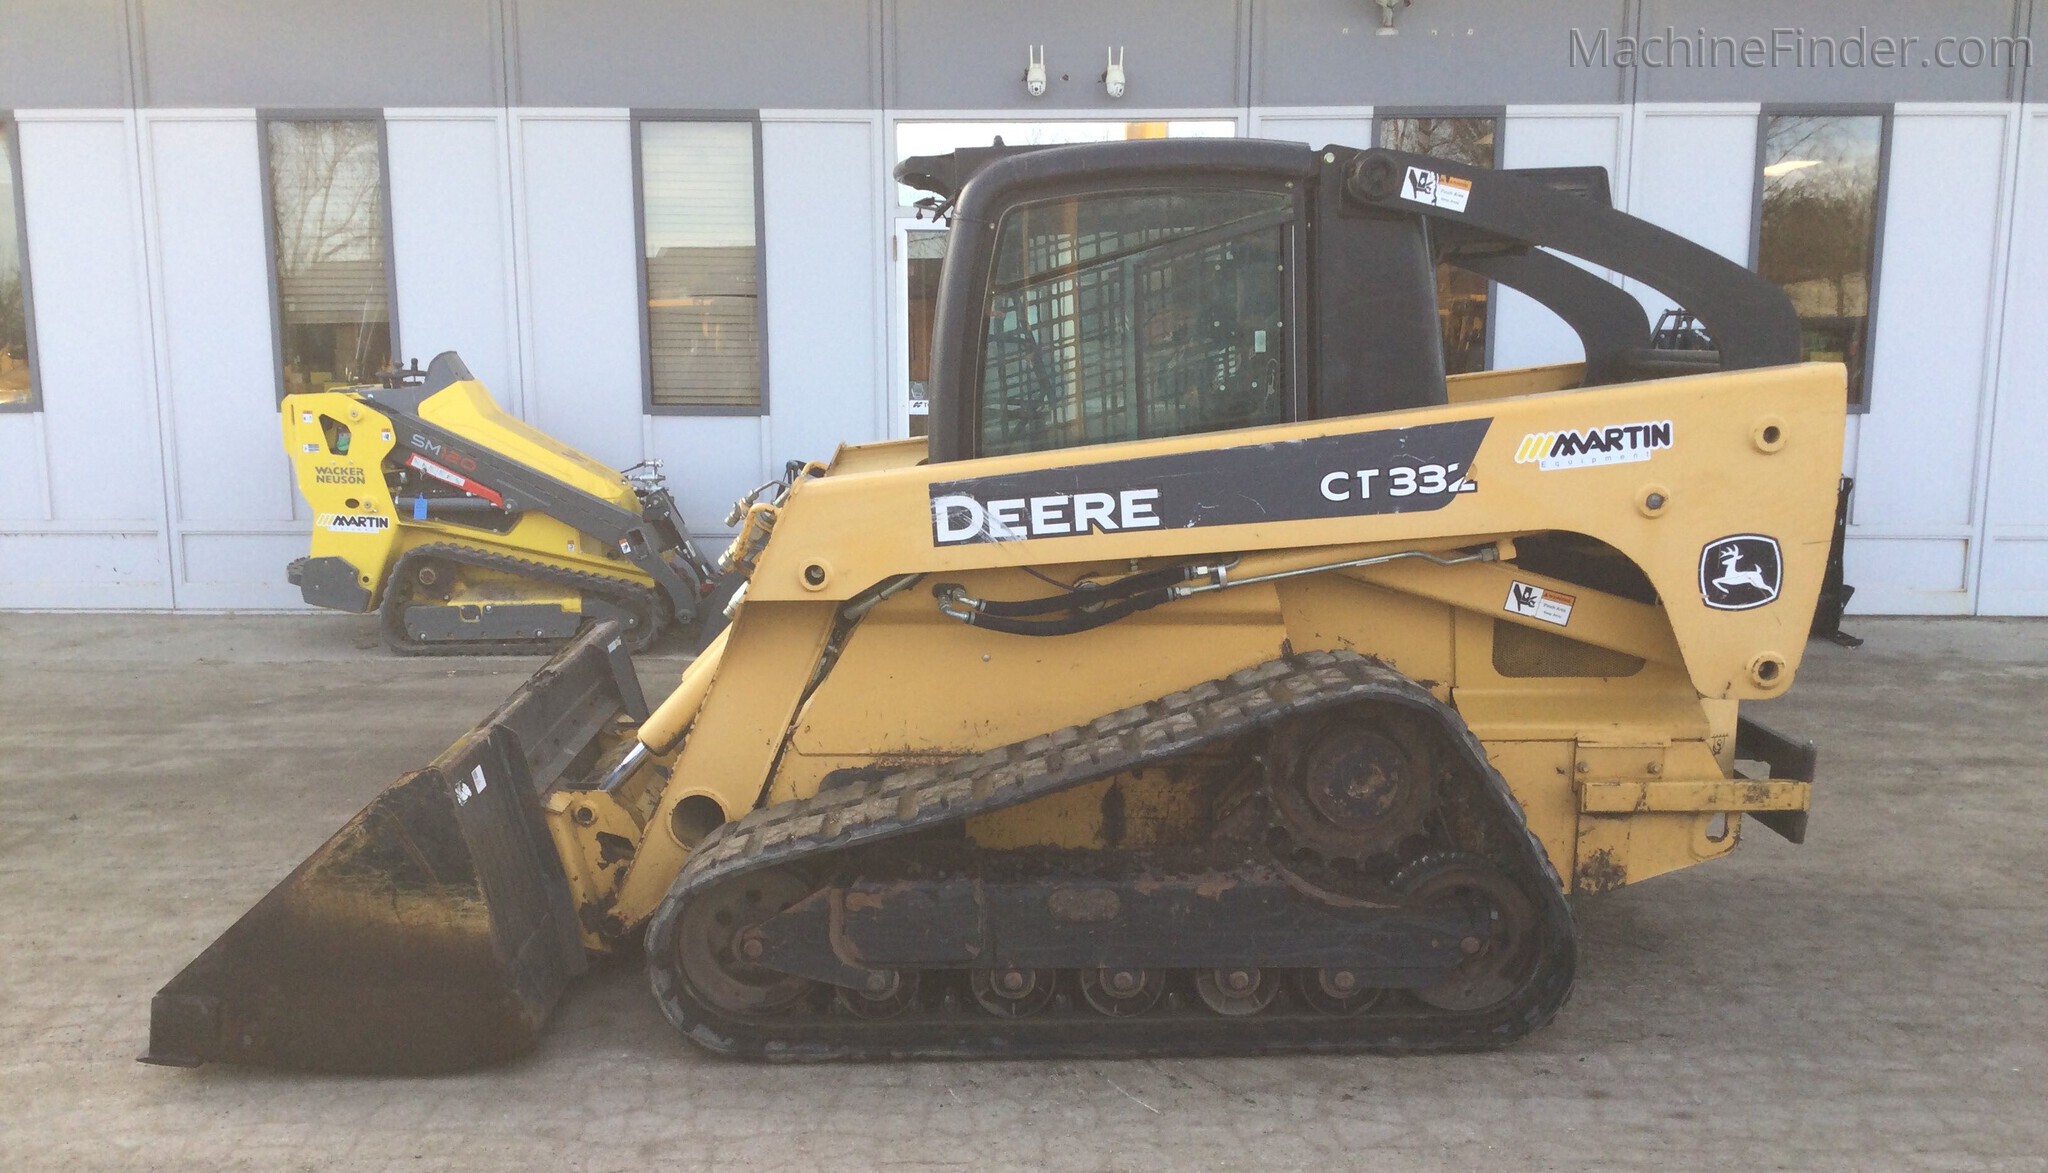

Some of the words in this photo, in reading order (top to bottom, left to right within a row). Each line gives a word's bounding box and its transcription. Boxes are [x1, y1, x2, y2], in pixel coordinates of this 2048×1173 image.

[1549, 422, 1671, 458] MARTIN
[1540, 451, 1650, 468] Equipment
[315, 466, 364, 476] WACKER
[316, 475, 366, 485] NEUSON
[332, 515, 389, 528] MARTIN
[934, 488, 1161, 544] DEERE
